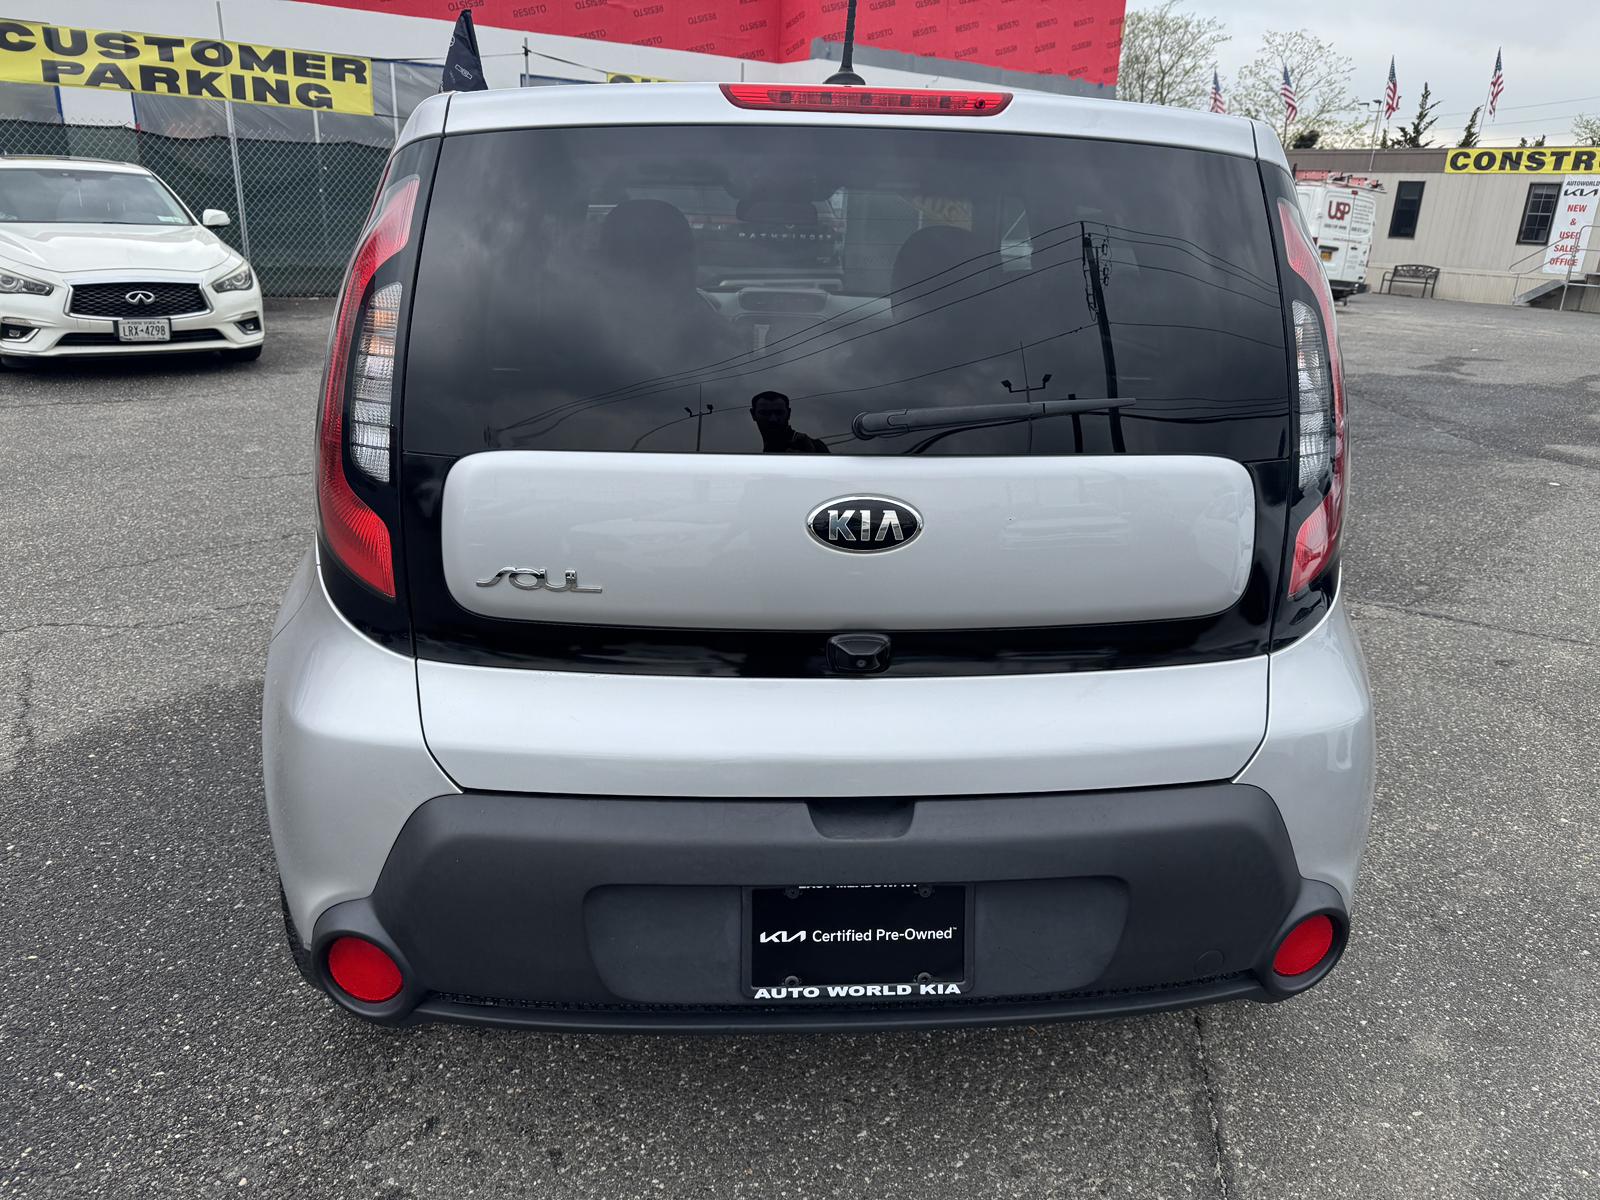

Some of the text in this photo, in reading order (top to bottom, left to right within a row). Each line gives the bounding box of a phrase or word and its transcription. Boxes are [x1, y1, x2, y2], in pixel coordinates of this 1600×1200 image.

[513, 4, 547, 18] RESISTO
[633, 4, 664, 18] RESISTO
[688, 12, 717, 25] RESISTO
[786, 11, 806, 29] RESISTO
[1036, 17, 1058, 29] RESISTO
[1074, 16, 1095, 28] RESISTO
[740, 20, 767, 32] RESISTO
[912, 25, 937, 37] RESISTO
[956, 21, 979, 33] RESISTO
[997, 20, 1020, 32] RESISTO
[867, 28, 893, 40] RESISTO
[0, 22, 367, 84] CUSTOMER
[955, 47, 978, 59] RESISTO
[41, 59, 334, 110] PARKING
[1450, 151, 1600, 171] CONSTR
[1567, 204, 1588, 212] NEW
[1570, 218, 1577, 226] &
[1553, 244, 1580, 253] SALES
[1549, 257, 1578, 267] OFFICE
[827, 509, 904, 541] KIA
[475, 566, 603, 594] SOUL
[812, 928, 872, 942] Certified
[754, 983, 962, 999] AUTO WORLD KIA
